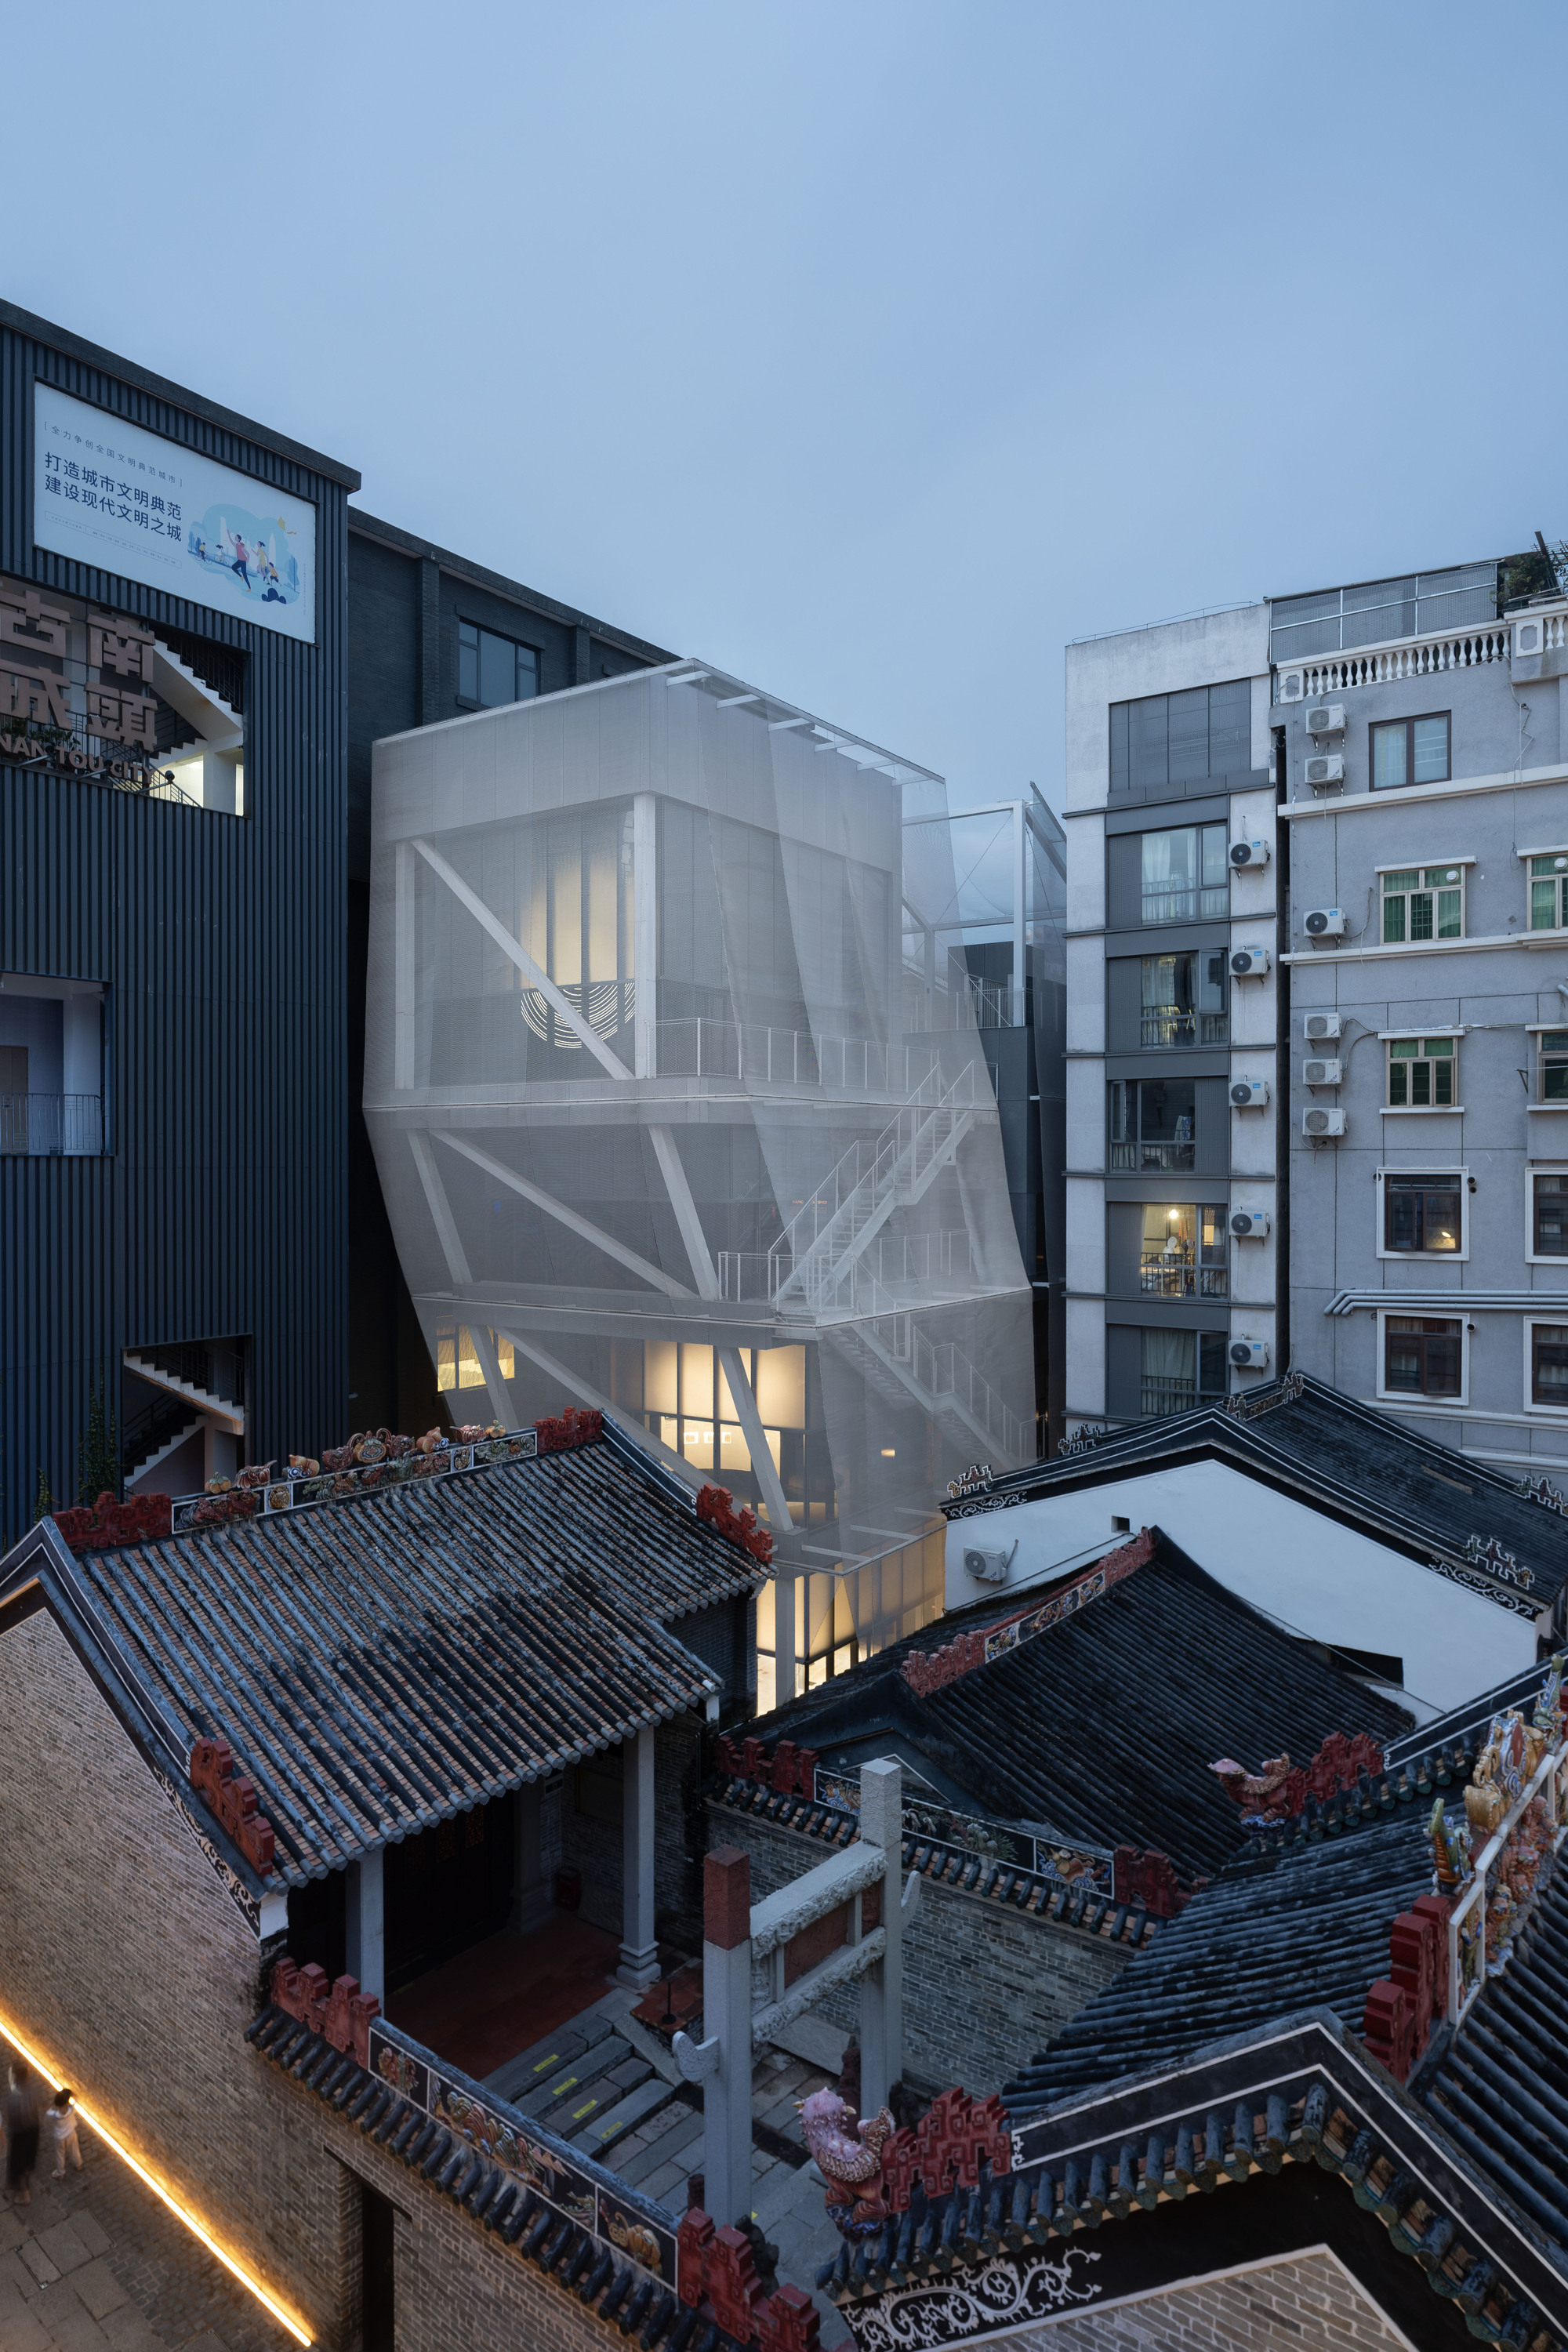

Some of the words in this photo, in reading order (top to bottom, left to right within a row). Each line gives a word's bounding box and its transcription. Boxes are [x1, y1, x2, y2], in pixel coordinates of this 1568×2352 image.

[44, 452, 182, 521] 打造城市文明典范
[44, 474, 182, 542] 建设现代文明之城
[54, 745, 103, 772] TOU
[110, 758, 157, 785] CITY
